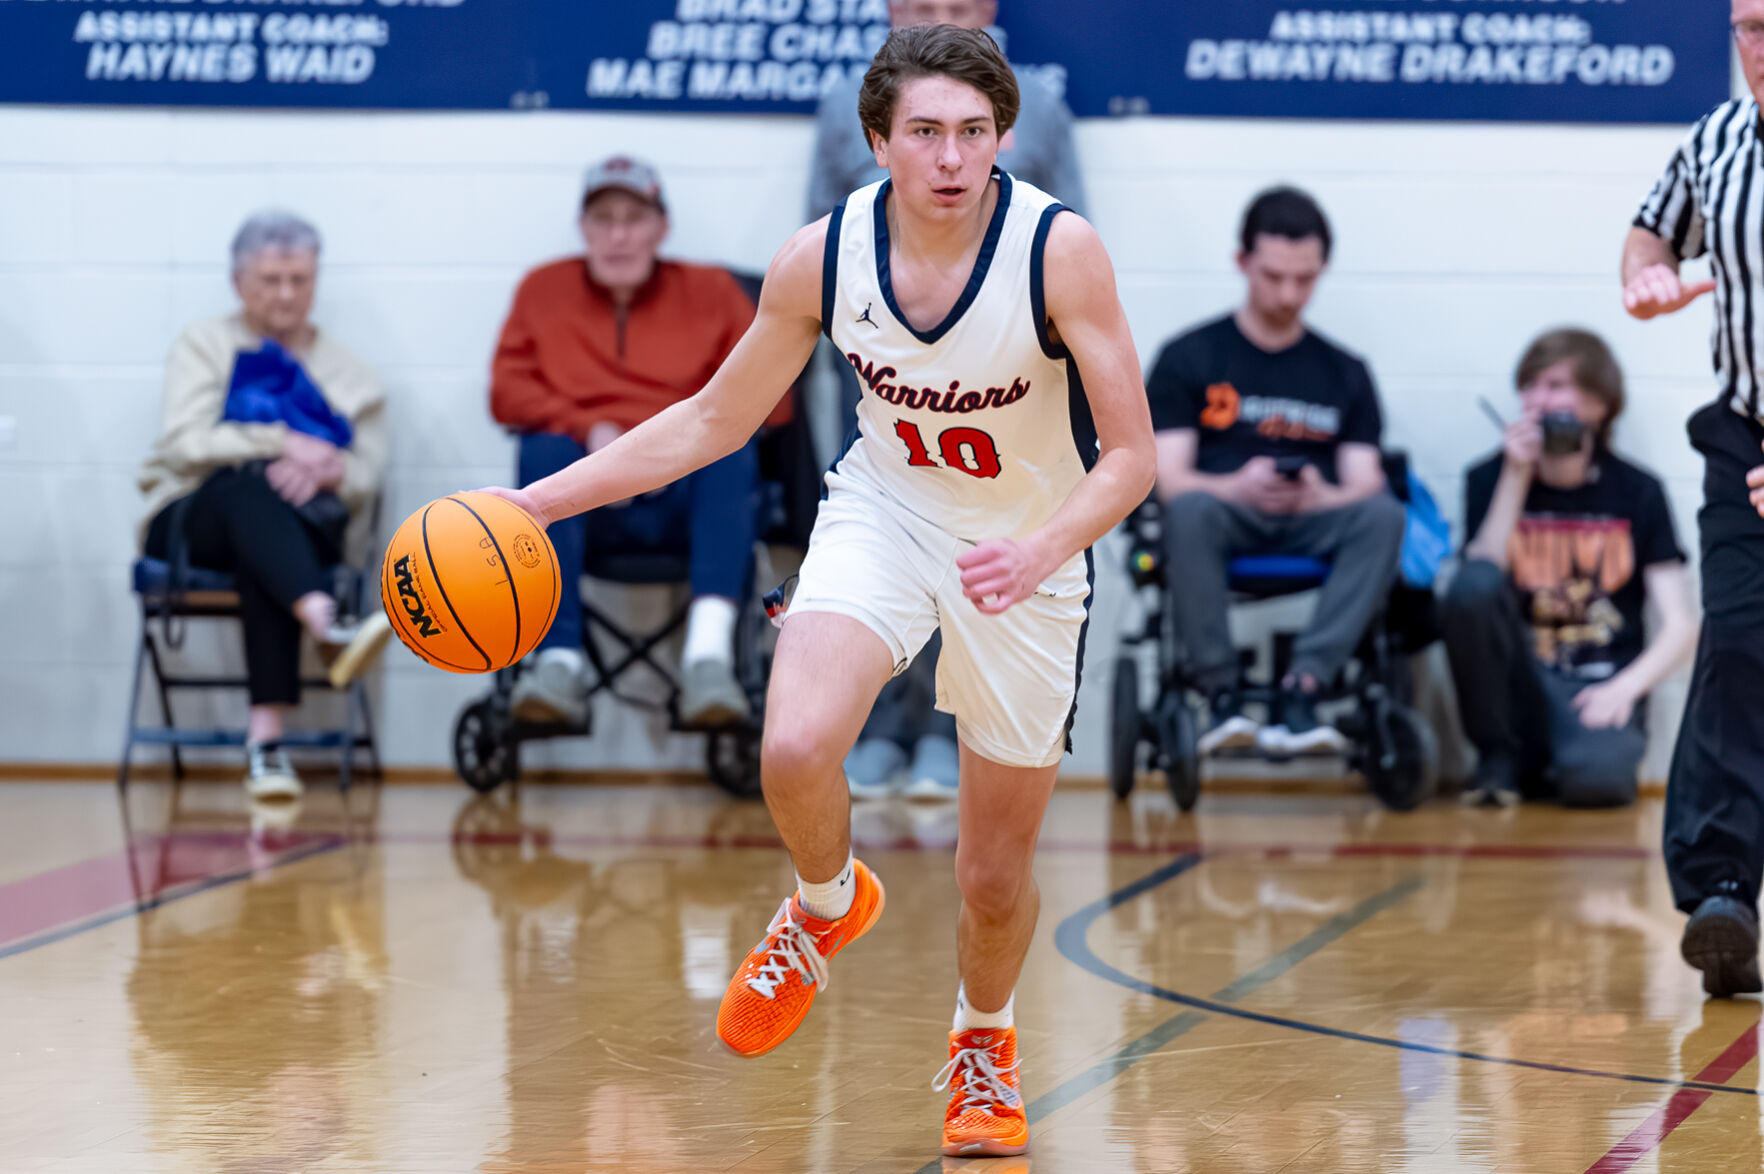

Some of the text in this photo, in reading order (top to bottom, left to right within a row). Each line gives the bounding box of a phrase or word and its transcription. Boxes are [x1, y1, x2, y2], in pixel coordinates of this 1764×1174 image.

[73, 11, 388, 46] ASSISTANT COACH:
[647, 21, 767, 61] BREE
[1270, 11, 1591, 46] ASSISTANT COACH:
[85, 42, 375, 83] HAYNES WAID
[586, 57, 684, 99] MAE
[1185, 39, 1674, 85] DEWAYNE DRAKEFORD
[847, 353, 1030, 413] Warriors
[893, 418, 1001, 479] 10
[394, 554, 441, 638] NCAA
